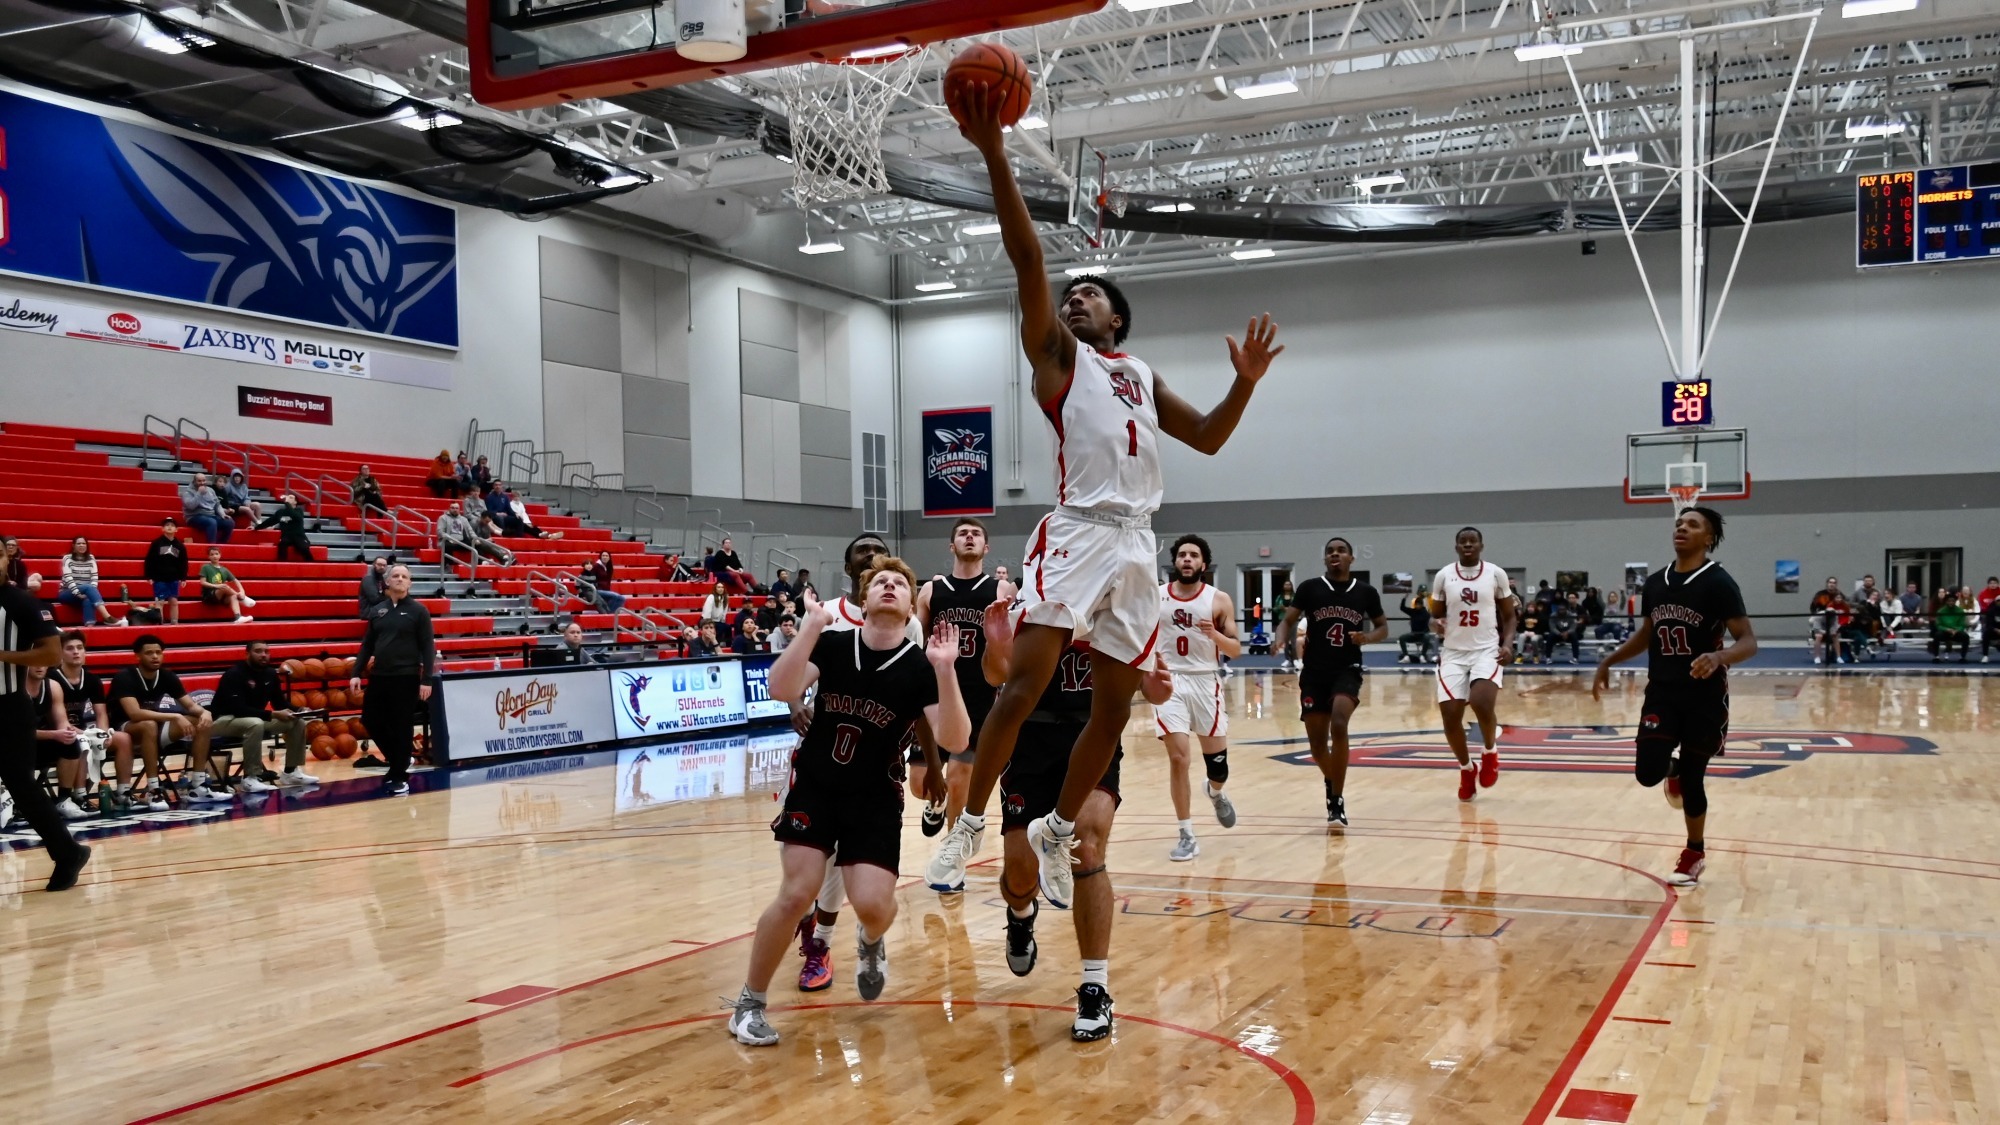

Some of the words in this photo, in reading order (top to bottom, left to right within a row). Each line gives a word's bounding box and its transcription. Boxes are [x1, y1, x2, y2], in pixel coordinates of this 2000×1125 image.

[1860, 176, 1877, 187] PLY
[1881, 175, 1892, 185] FL
[1894, 173, 1913, 184] PTS
[1870, 187, 1878, 198] 0
[1883, 185, 1891, 196] 0
[1905, 184, 1912, 193] 7
[1918, 190, 1974, 204] HORNETS
[1900, 197, 1912, 208] 10
[1904, 209, 1912, 220] 6
[1883, 224, 1891, 235] 2
[1904, 223, 1912, 233] 6
[1924, 226, 1946, 234] FOULS
[1904, 236, 1912, 247] 2
[111, 317, 138, 331] Hood
[183, 325, 276, 361] ZAXBY'S
[1109, 372, 1143, 406] SU
[1674, 382, 1708, 399] 2:43
[295, 399, 308, 411] Pep
[308, 401, 325, 411] Band
[1672, 397, 1702, 422] 28
[1126, 419, 1137, 457] 1
[930, 451, 988, 474] SHENANDOAH
[941, 465, 976, 476] HORNETS
[1461, 587, 1478, 604] SU
[933, 607, 985, 628] OANOK
[1173, 608, 1193, 629] SU
[1313, 605, 1363, 626] ROANOKE
[1459, 610, 1480, 627] 25
[1326, 622, 1345, 647] 4
[1657, 626, 1692, 656] 11
[1176, 636, 1189, 657] 0
[745, 668, 763, 679] Think
[1061, 652, 1093, 691] 12
[747, 679, 771, 701] Thi
[496, 688, 527, 730] Glory
[526, 678, 558, 714] Days
[527, 709, 547, 717] GRILL
[656, 712, 746, 730] www.SUHornets.com
[485, 730, 584, 753] WWW.GLORYDAYSGRILL.COM
[832, 722, 862, 765] 0
